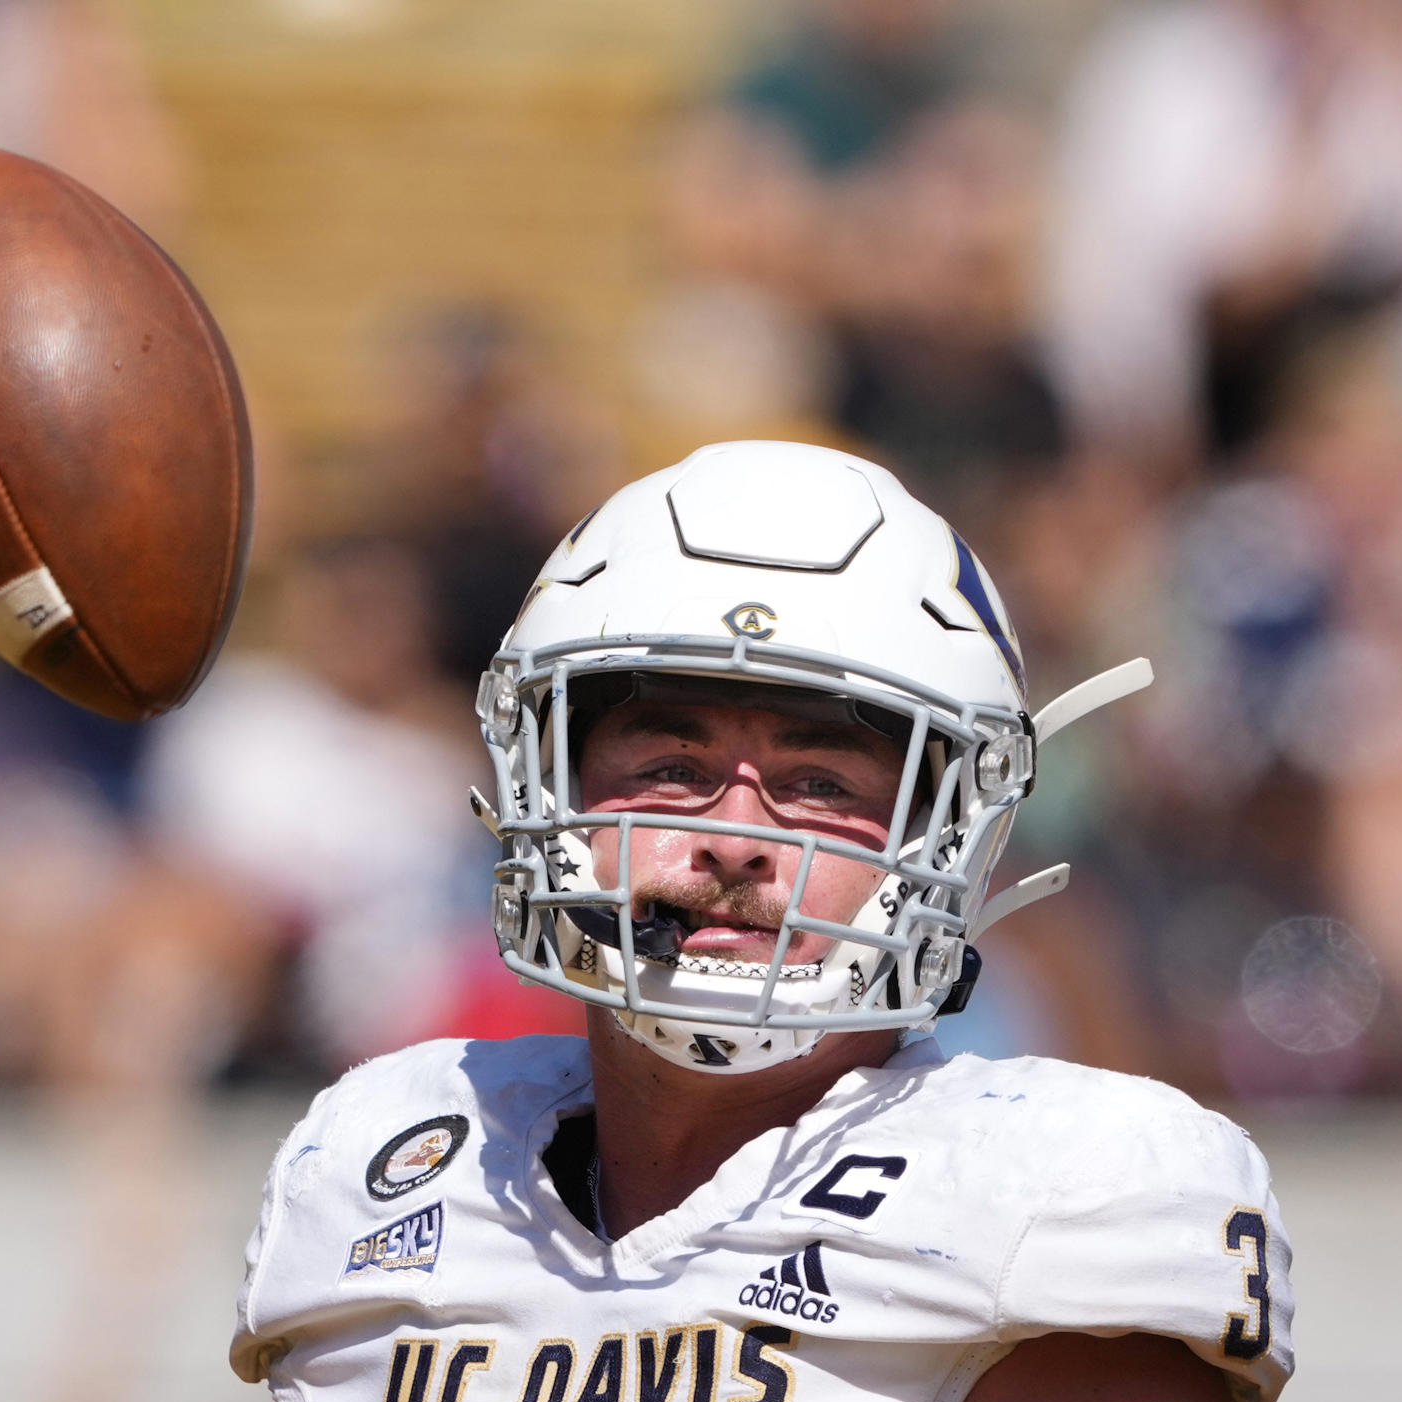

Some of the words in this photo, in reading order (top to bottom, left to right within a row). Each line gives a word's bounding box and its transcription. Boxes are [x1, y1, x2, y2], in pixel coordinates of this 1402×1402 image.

[800, 1154, 907, 1220] C
[738, 1281, 840, 1324] adidas
[1220, 1205, 1271, 1361] 3
